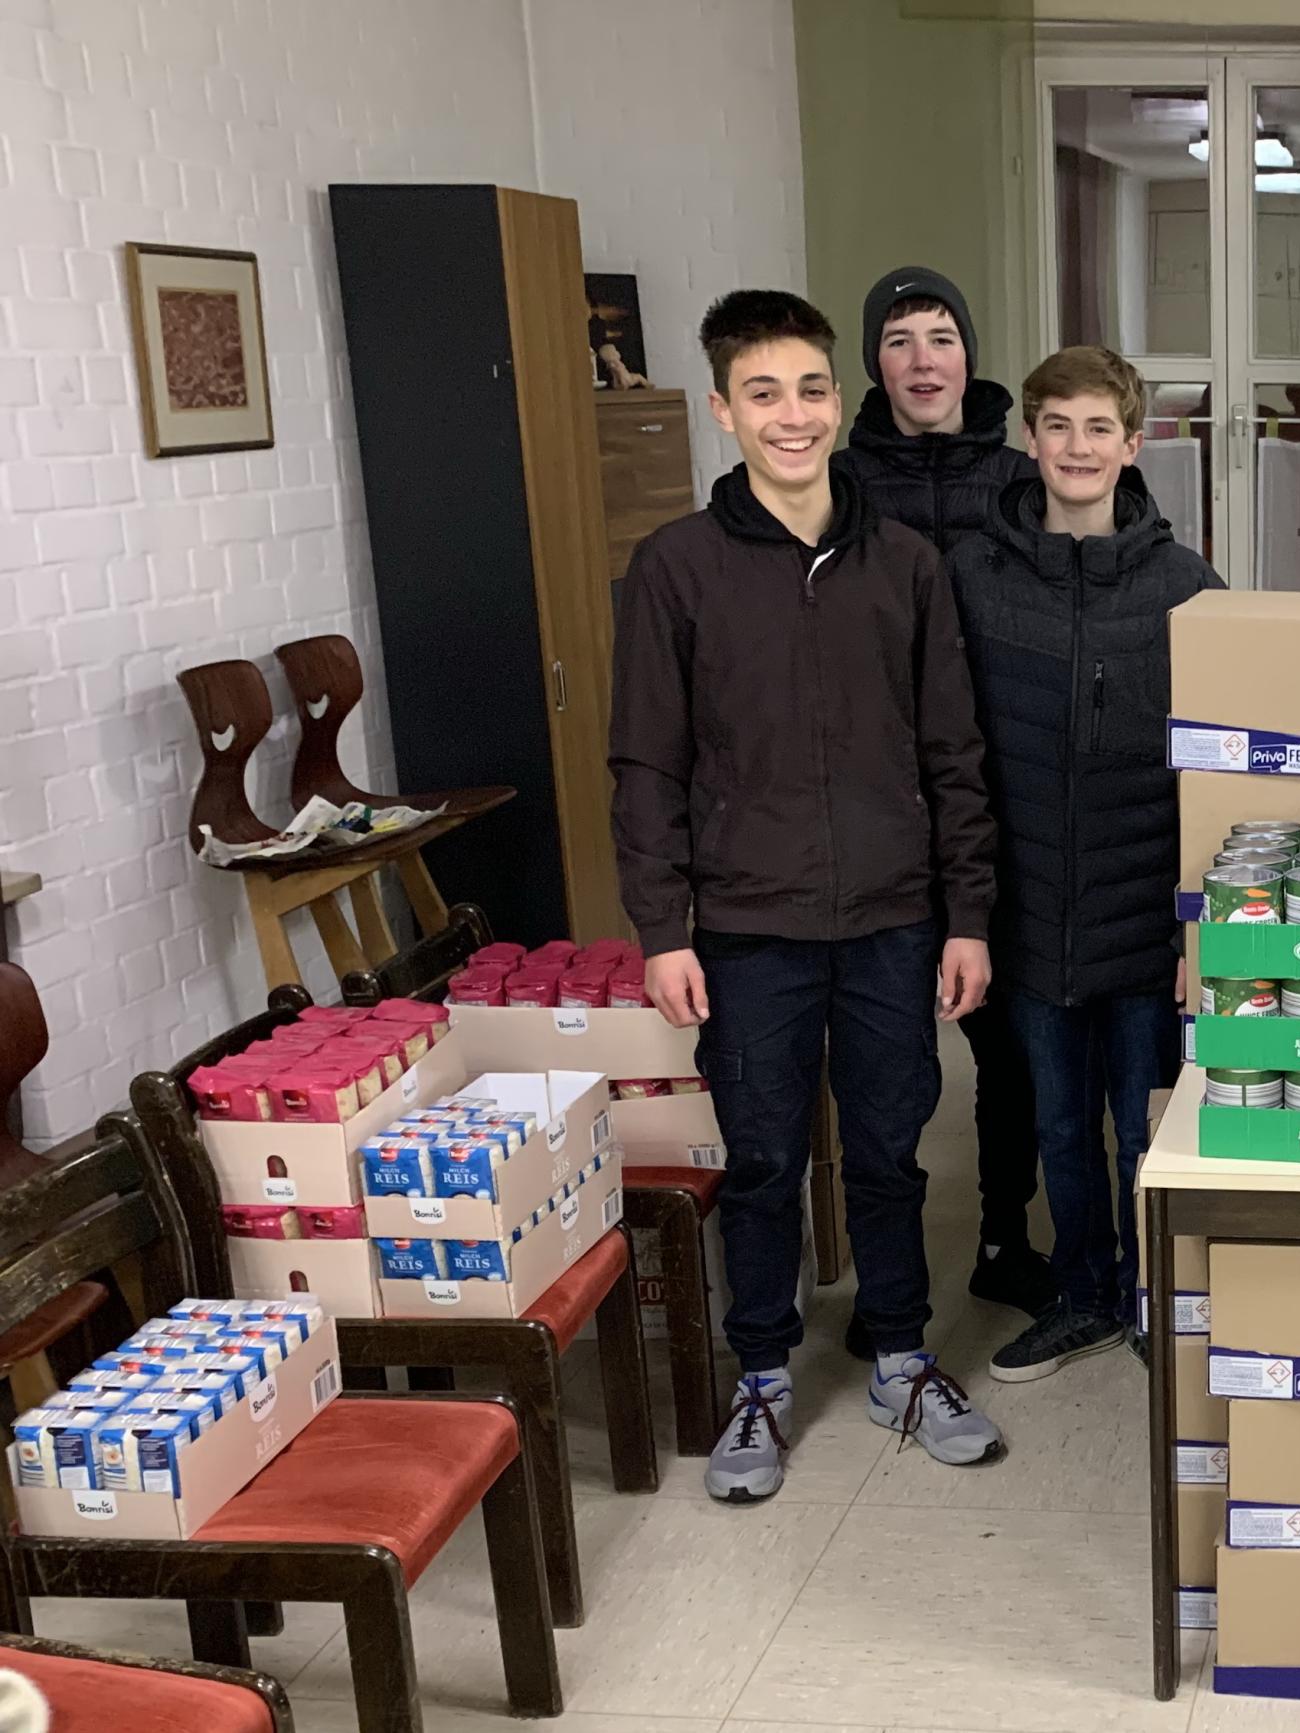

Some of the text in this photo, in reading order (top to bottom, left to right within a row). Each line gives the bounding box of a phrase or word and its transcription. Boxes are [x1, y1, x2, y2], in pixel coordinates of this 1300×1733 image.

[1252, 750, 1285, 764] Priva
[374, 1173, 410, 1184] REIS
[442, 1173, 480, 1185] REIS
[388, 1260, 424, 1271] REIS
[454, 1258, 491, 1269] REIS
